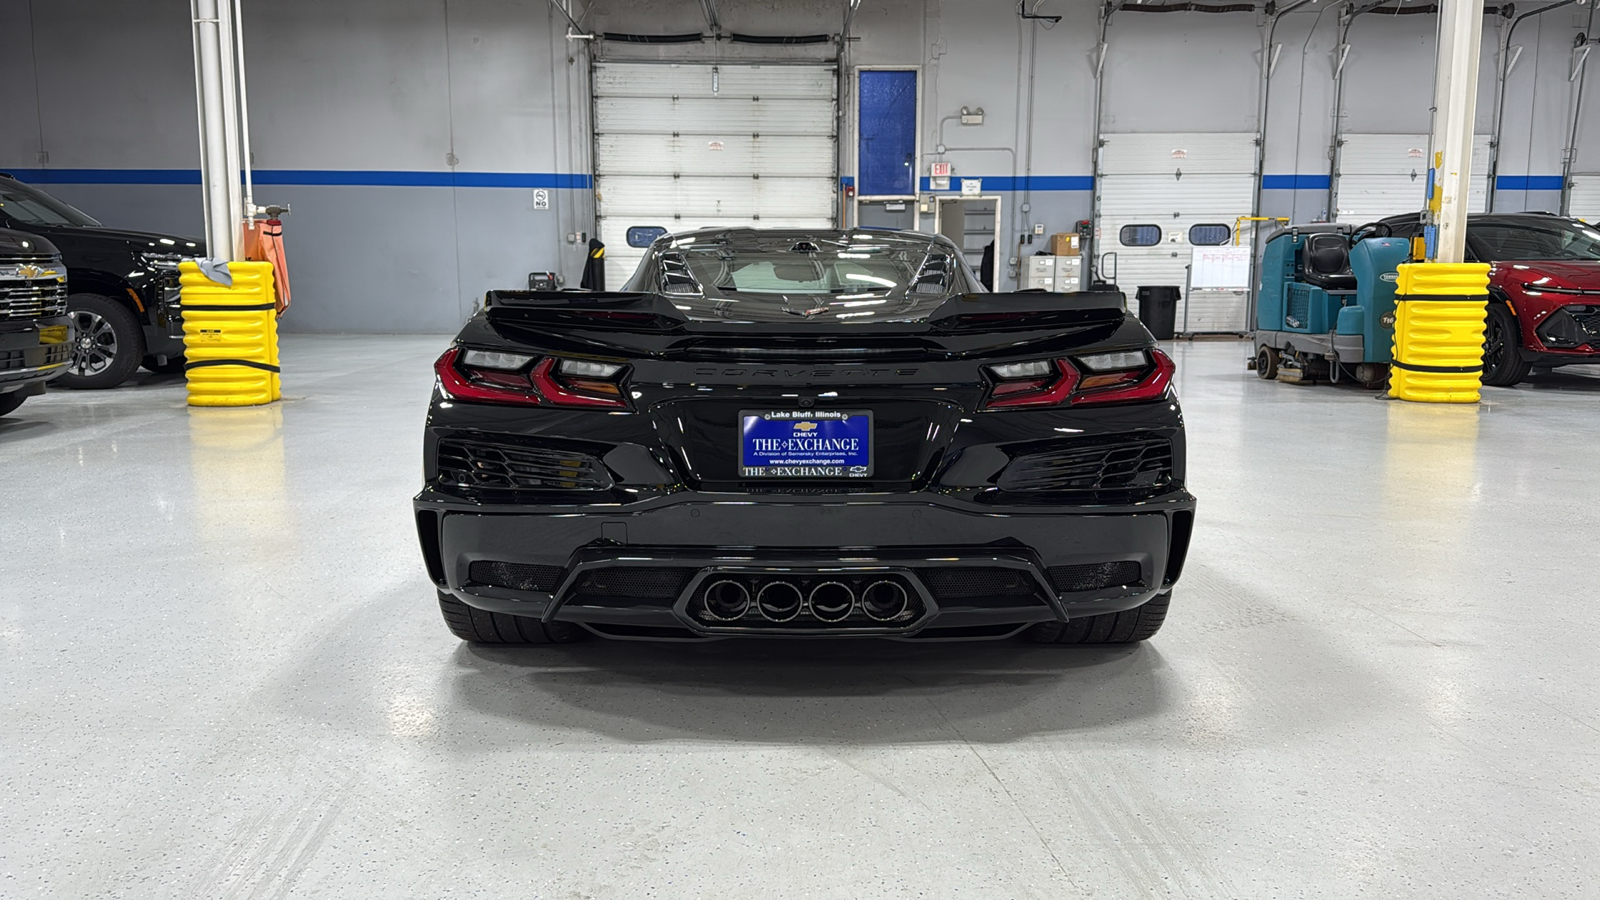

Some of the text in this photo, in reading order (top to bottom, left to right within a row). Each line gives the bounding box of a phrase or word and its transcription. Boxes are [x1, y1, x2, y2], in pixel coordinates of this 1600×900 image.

[934, 163, 949, 175] EXIT
[694, 368, 919, 377] CORVETTE
[752, 438, 859, 451] THE EXCHANGE
[743, 467, 843, 476] THE EXCHANGE
